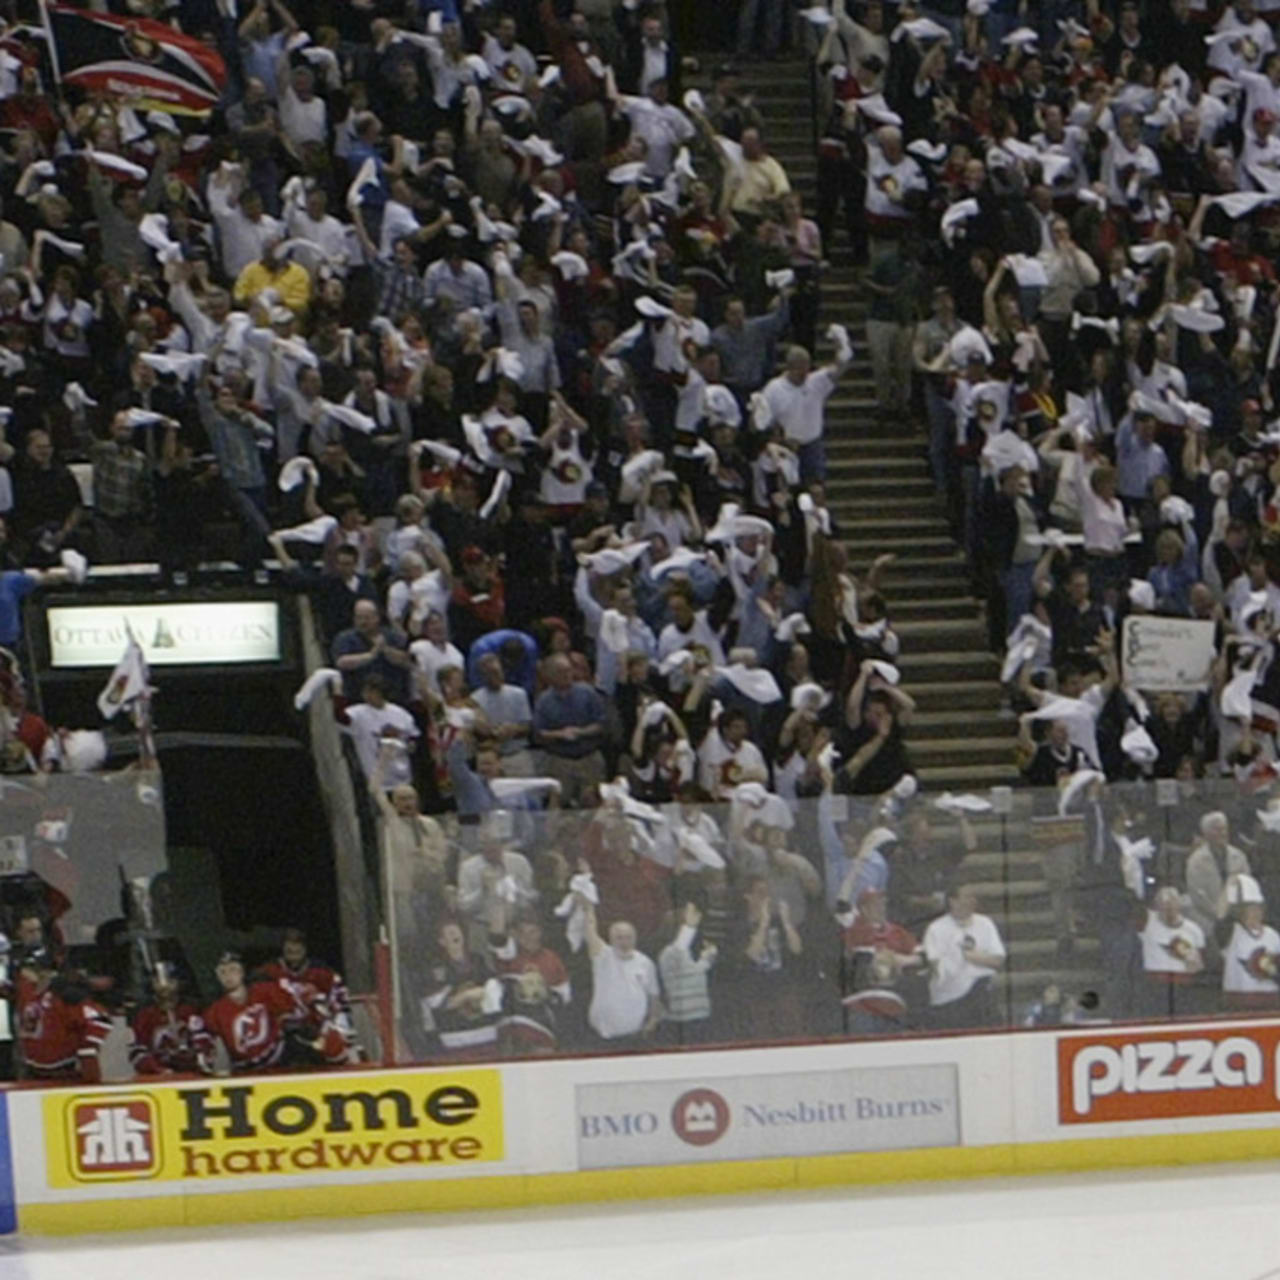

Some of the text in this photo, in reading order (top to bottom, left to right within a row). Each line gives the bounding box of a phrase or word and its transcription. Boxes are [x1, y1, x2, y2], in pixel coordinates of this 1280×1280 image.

[178, 1086, 480, 1141] Home
[580, 1111, 659, 1138] BMO
[742, 1096, 944, 1128] Nesbitt Burns
[182, 1136, 482, 1177] hardware
